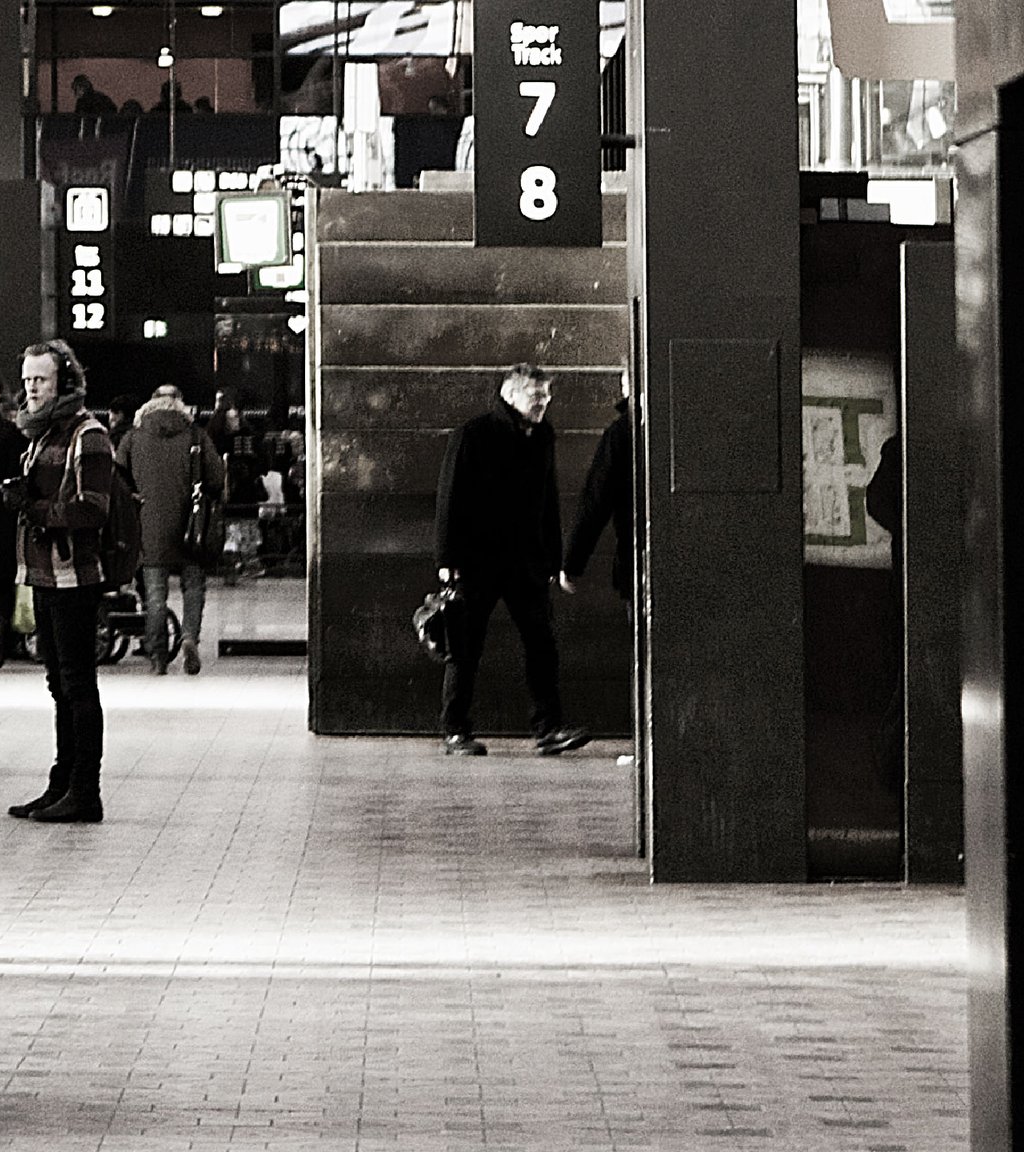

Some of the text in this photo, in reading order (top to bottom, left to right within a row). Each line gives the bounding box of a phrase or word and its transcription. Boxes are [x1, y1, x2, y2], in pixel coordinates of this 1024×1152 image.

[519, 81, 556, 137] 7
[519, 165, 558, 221] 8
[71, 269, 105, 297] 11
[71, 302, 105, 329] 12
